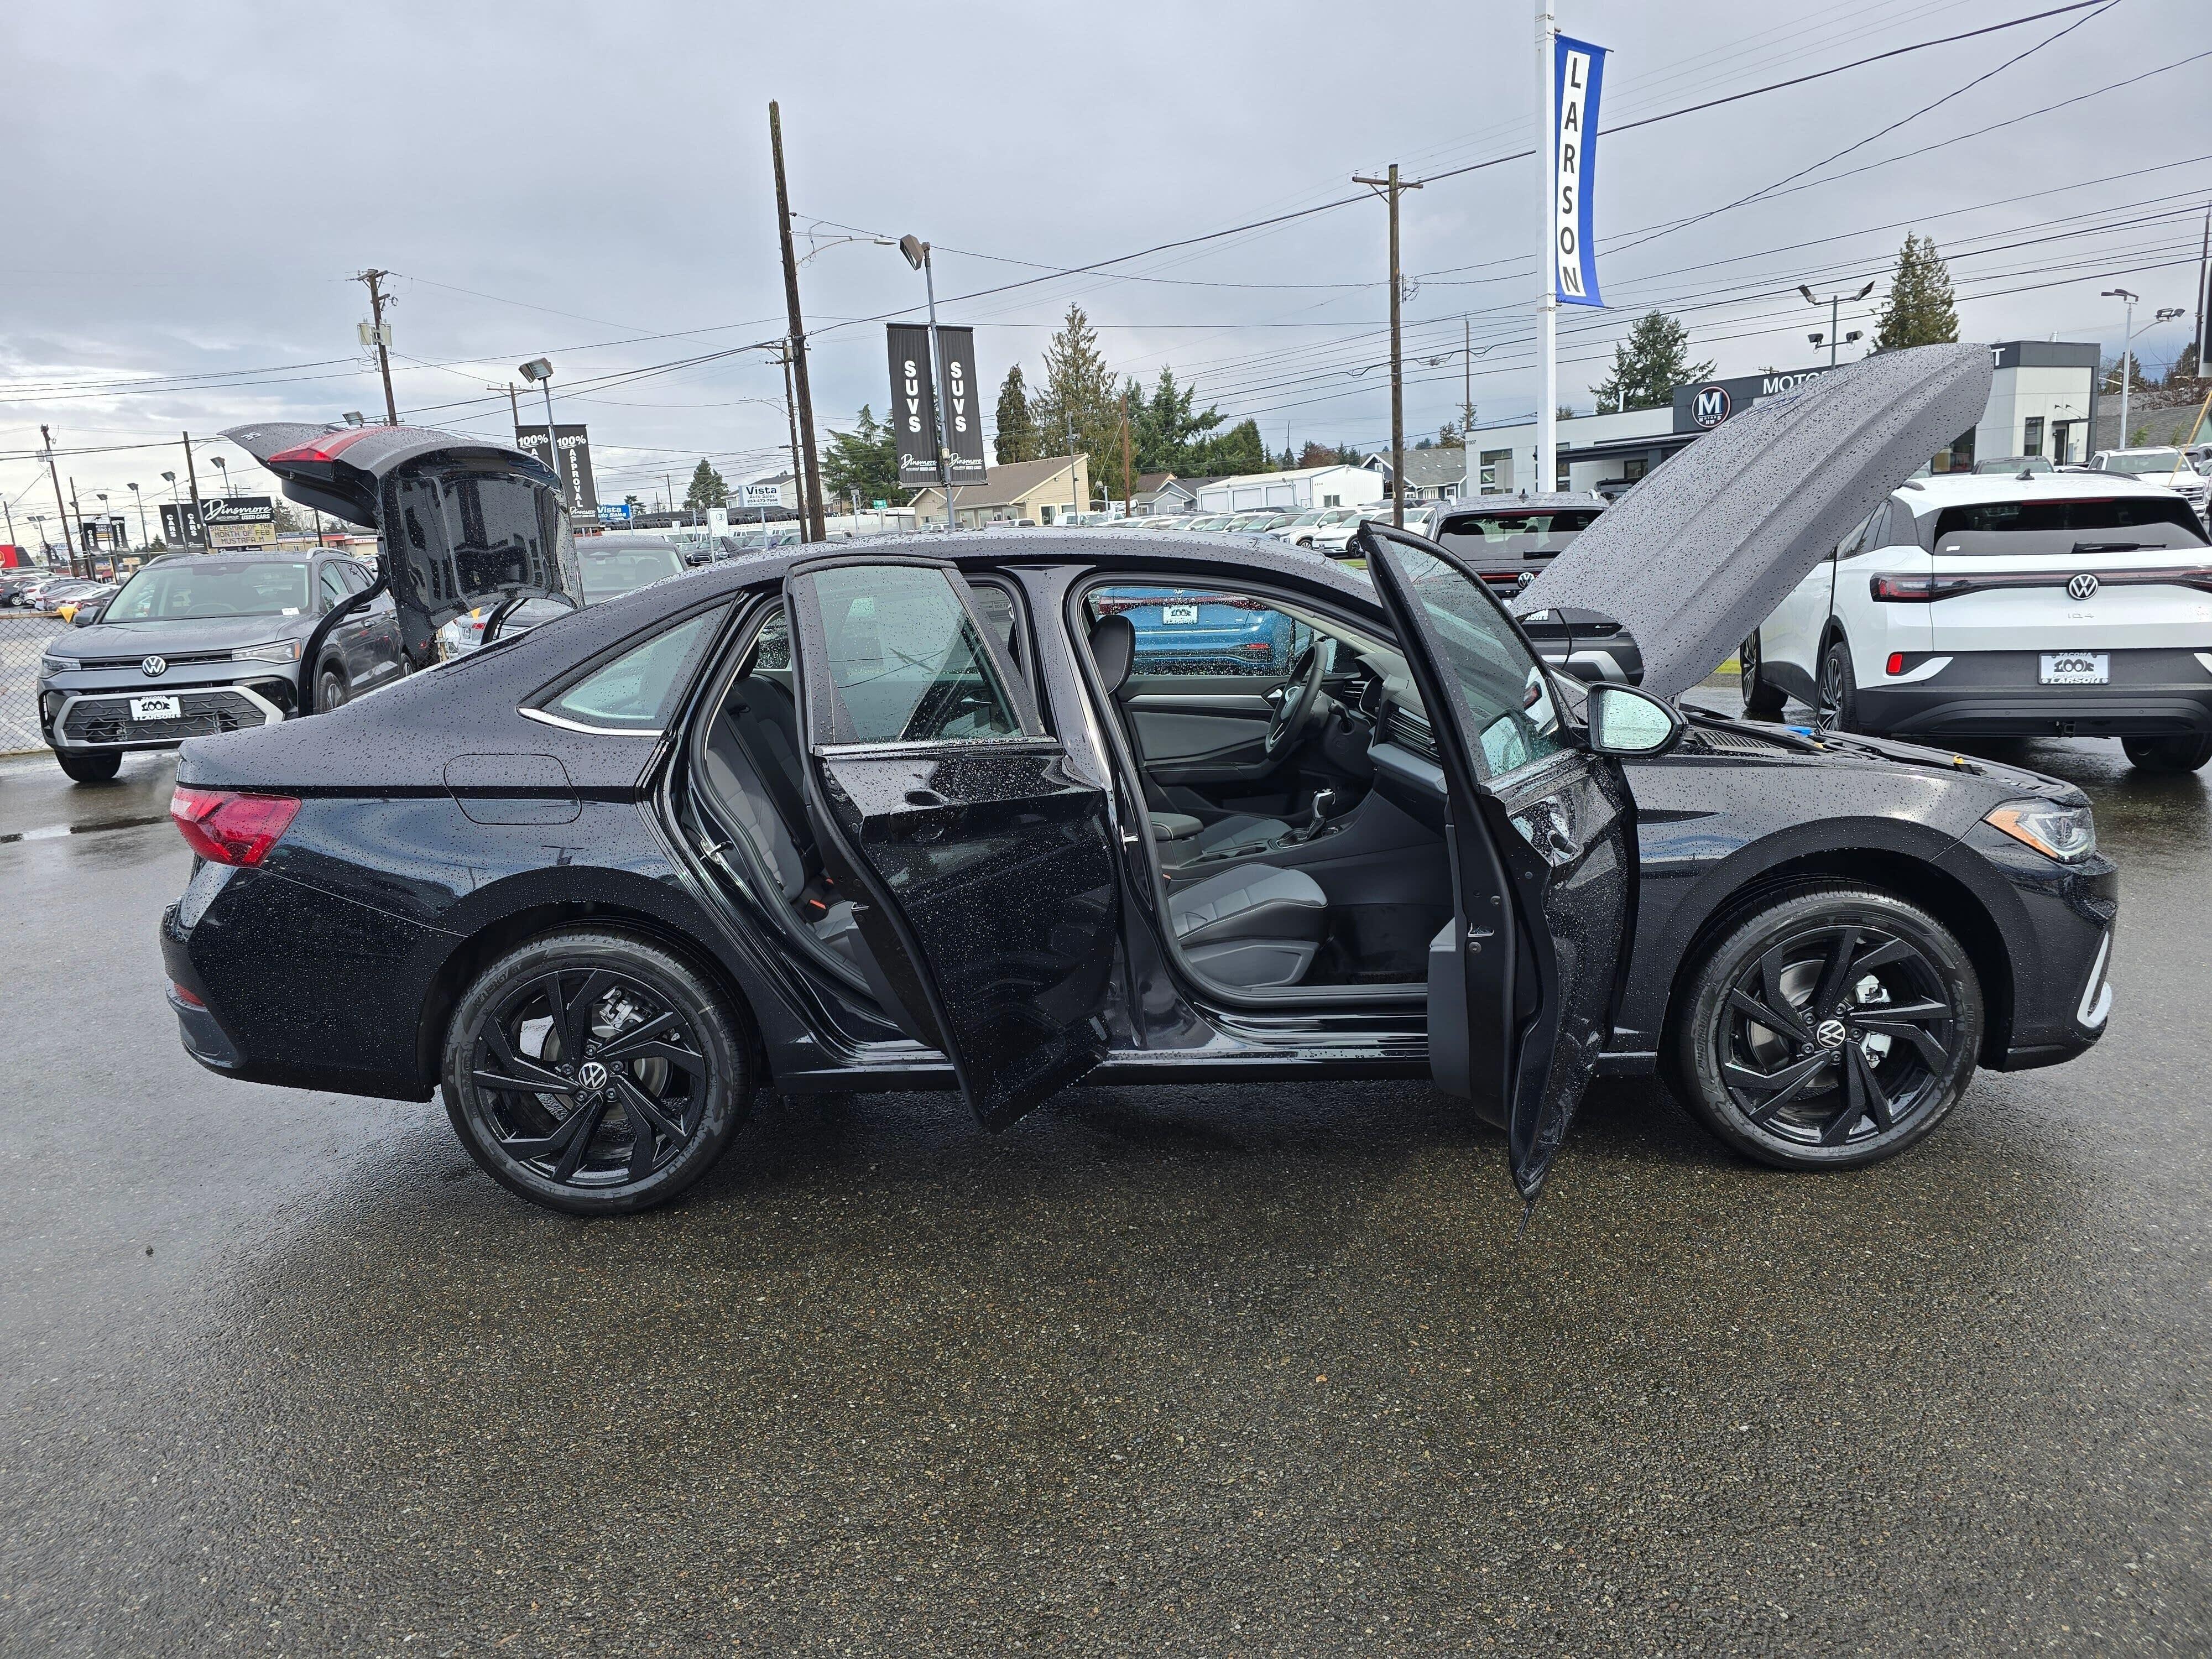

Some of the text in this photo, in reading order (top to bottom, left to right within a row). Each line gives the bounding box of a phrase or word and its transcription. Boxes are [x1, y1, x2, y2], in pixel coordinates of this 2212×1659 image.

[1560, 57, 1581, 294] LARSON
[1763, 372, 1829, 394] MOT
[904, 360, 921, 432] SUVS
[951, 361, 967, 432] SUVS
[1698, 391, 1722, 415] M
[518, 434, 549, 448] 100%
[557, 435, 587, 448] 100%
[569, 448, 583, 508] APPROVAL
[746, 486, 777, 494] Vista
[203, 499, 272, 521] Dinsmore
[166, 514, 177, 538] CARS
[187, 513, 197, 536] CARS
